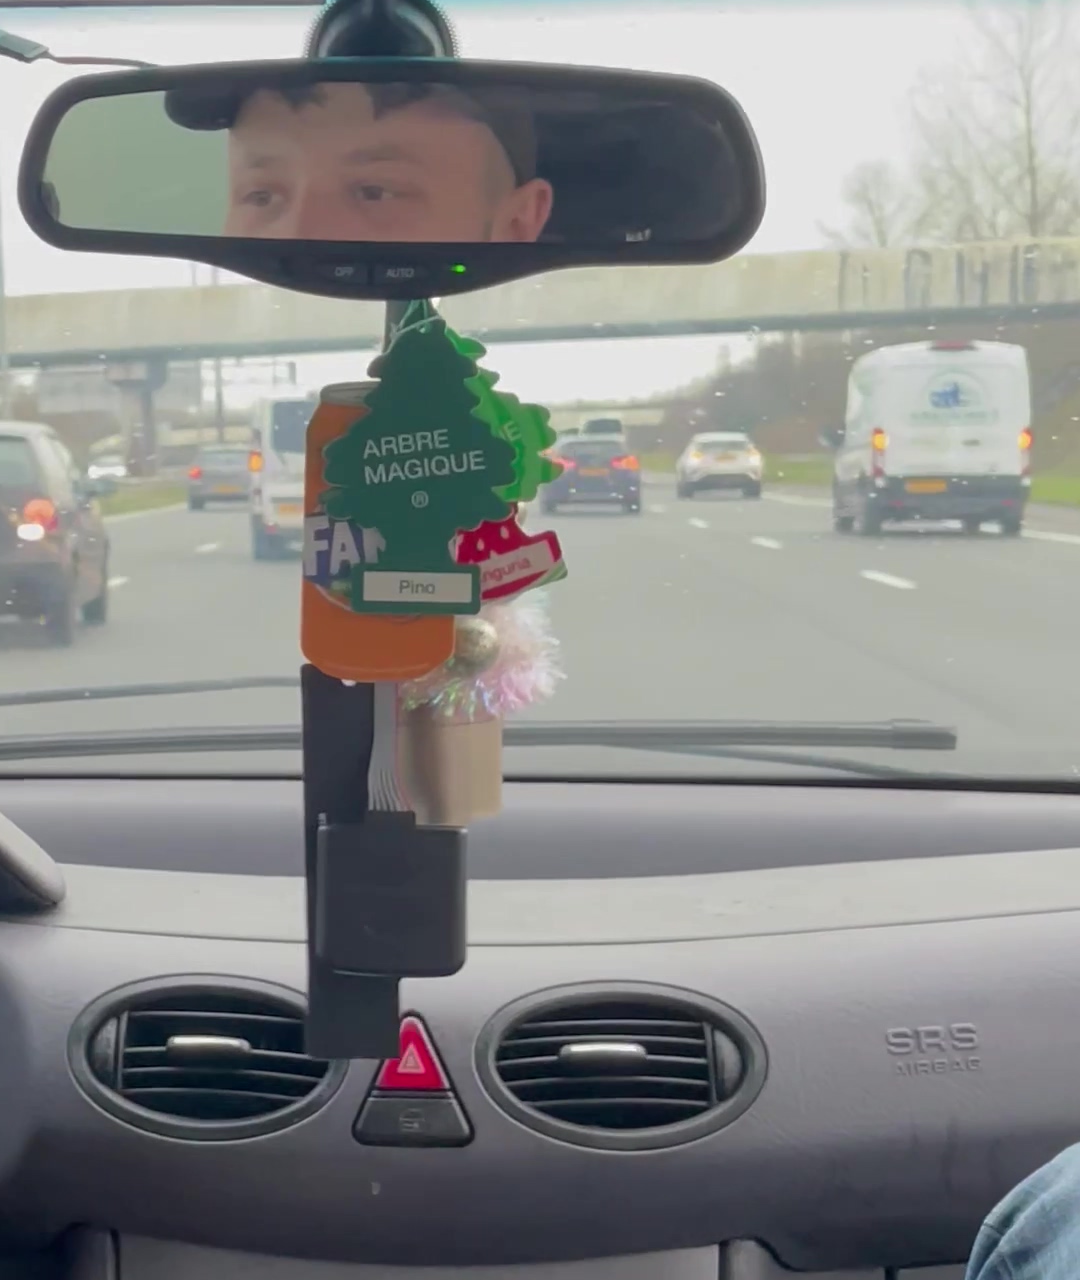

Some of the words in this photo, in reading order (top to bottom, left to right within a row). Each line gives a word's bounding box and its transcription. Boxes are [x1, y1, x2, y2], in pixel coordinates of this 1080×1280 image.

[386, 268, 415, 278] AUTO
[363, 429, 450, 459] ARBRE
[364, 450, 486, 485] MAGIQUE
[481, 555, 531, 584] nguria
[399, 580, 436, 595] Pino
[886, 1022, 978, 1055] SRS
[894, 1056, 981, 1077] AIRBAG
